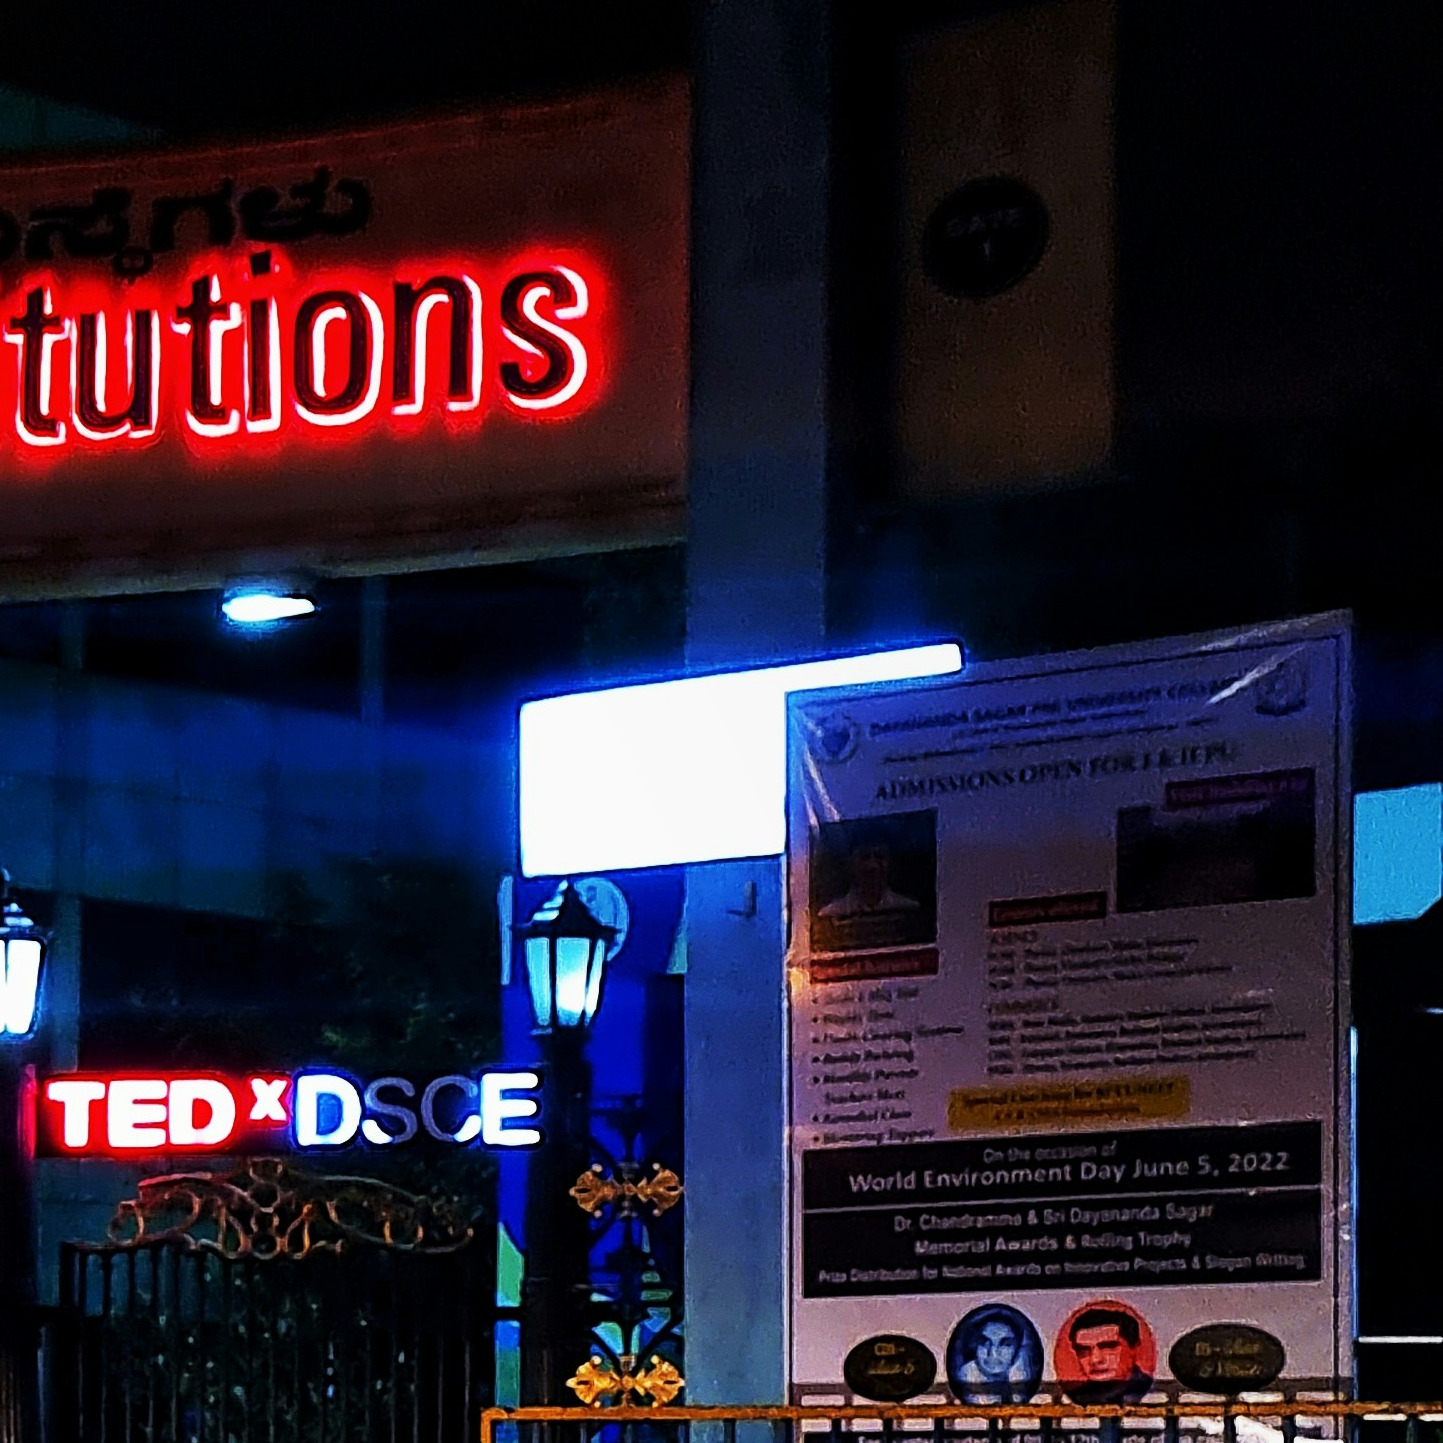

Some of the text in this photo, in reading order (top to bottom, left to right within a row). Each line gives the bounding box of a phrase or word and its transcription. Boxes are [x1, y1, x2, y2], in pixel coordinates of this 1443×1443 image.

[876, 769, 1015, 799] ADMISSIONS
[848, 1150, 1293, 1193] World Environment Day June 5, 2022
[1026, 1209, 1039, 1227] &
[1069, 1204, 1161, 1227] Dayananda
[913, 1235, 990, 1256] Memorial
[994, 1234, 1060, 1253] Awards
